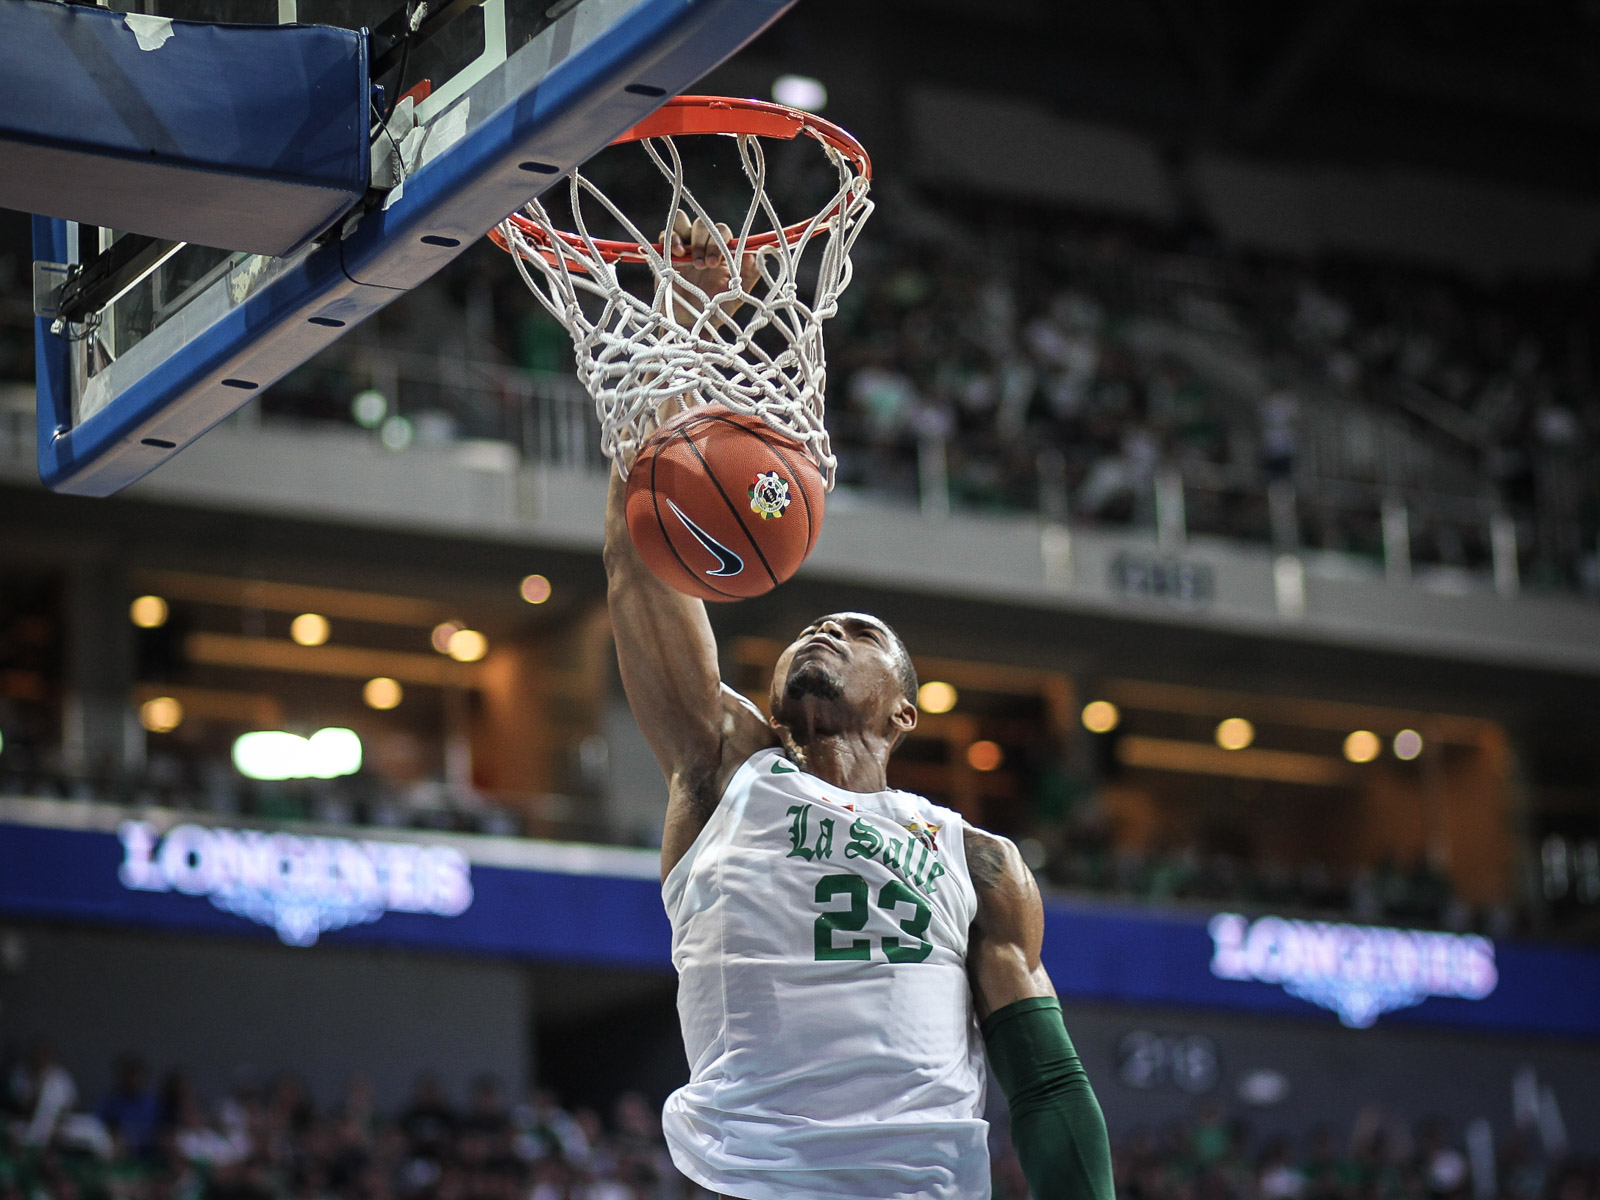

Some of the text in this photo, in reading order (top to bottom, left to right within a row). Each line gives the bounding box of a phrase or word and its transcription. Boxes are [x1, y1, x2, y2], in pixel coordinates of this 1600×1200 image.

[786, 804, 945, 895] La Salle
[814, 873, 934, 964] 23
